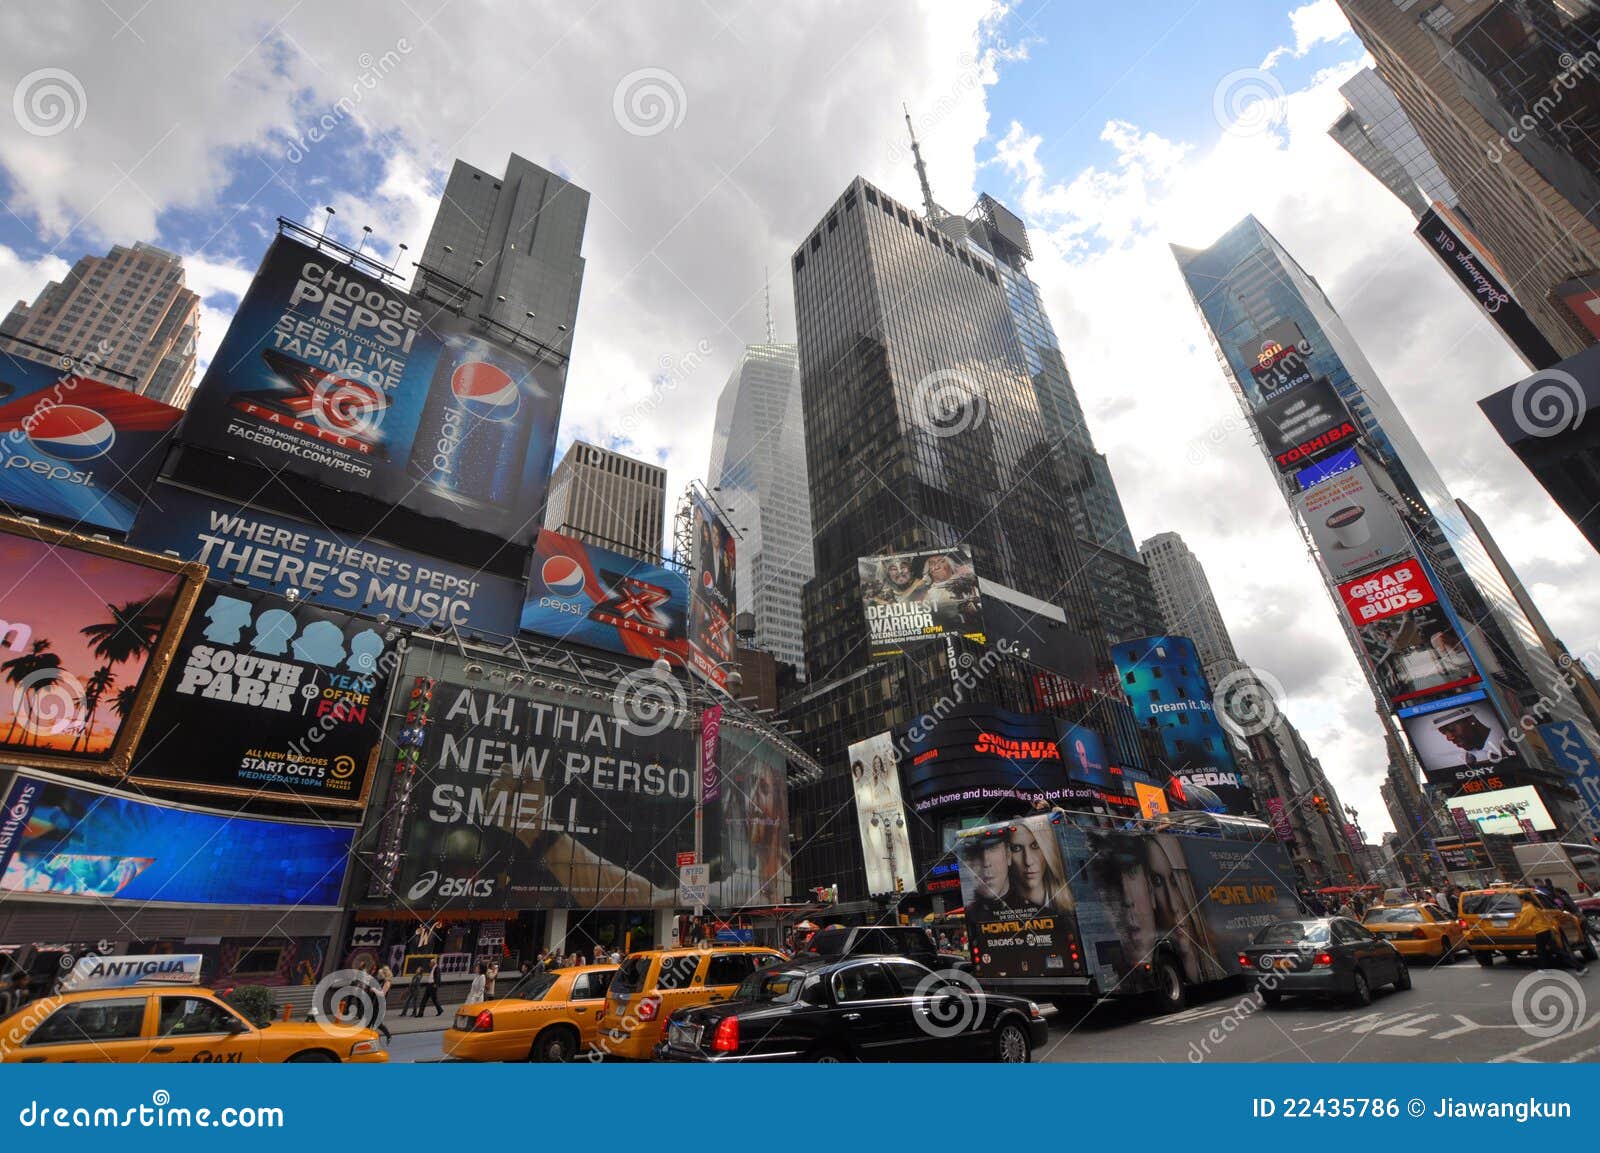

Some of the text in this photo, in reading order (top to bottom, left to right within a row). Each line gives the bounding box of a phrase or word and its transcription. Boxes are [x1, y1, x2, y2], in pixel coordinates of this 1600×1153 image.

[300, 262, 423, 327] CHOOSE
[289, 278, 418, 354] PEPSI
[274, 314, 406, 379] SEE A LIVE
[308, 316, 387, 354] AND YOU COULD
[273, 330, 402, 391] TAPING OF
[1265, 373, 1310, 401] minutes
[246, 405, 370, 454] FACTOR
[258, 425, 351, 460] FOR MORE DETAILS VISIT
[432, 406, 461, 475] pepsi
[1276, 423, 1356, 467] TOSHIBA
[226, 423, 373, 480] FACEBOOK.COM/PEPSI
[4, 454, 97, 488] pepsi
[208, 510, 480, 600] WHERE THERE'S PEPSI
[196, 533, 472, 628] THERE'S MUSIC
[1350, 567, 1413, 600] GRAB
[1366, 584, 1408, 604] SOME
[538, 596, 584, 617] pepsi
[866, 600, 939, 620] DEADLIEST
[1358, 588, 1424, 620] BUDS
[869, 614, 934, 633] WARRIOR
[870, 629, 922, 640] WEDNESDAYS
[187, 644, 305, 688] SOUTH
[175, 667, 303, 712] PARK
[303, 686, 317, 697] 15
[323, 687, 371, 706] OF THE
[328, 672, 373, 694] YEAR
[316, 699, 368, 725] FAN
[445, 688, 520, 736] AH,
[529, 701, 630, 749] THAT
[1149, 701, 1188, 715] Dream
[1188, 700, 1201, 711] it.
[241, 757, 325, 778] START OCT 5
[245, 748, 329, 766] ALL NEW EPISODES
[438, 733, 550, 781] NEW
[563, 751, 699, 800] PERSO
[1455, 766, 1496, 780] SONY
[1550, 725, 1600, 810] RYX
[238, 769, 323, 787] WEDNESDAYS 10PM
[1179, 772, 1240, 789] ASDAQ
[429, 783, 599, 836] SMELL.
[939, 792, 961, 804] home
[962, 788, 981, 799] and
[1045, 789, 1061, 799] hot
[1062, 787, 1075, 798] it's
[438, 877, 496, 897] asics
[88, 959, 186, 978] ANTIGUA
